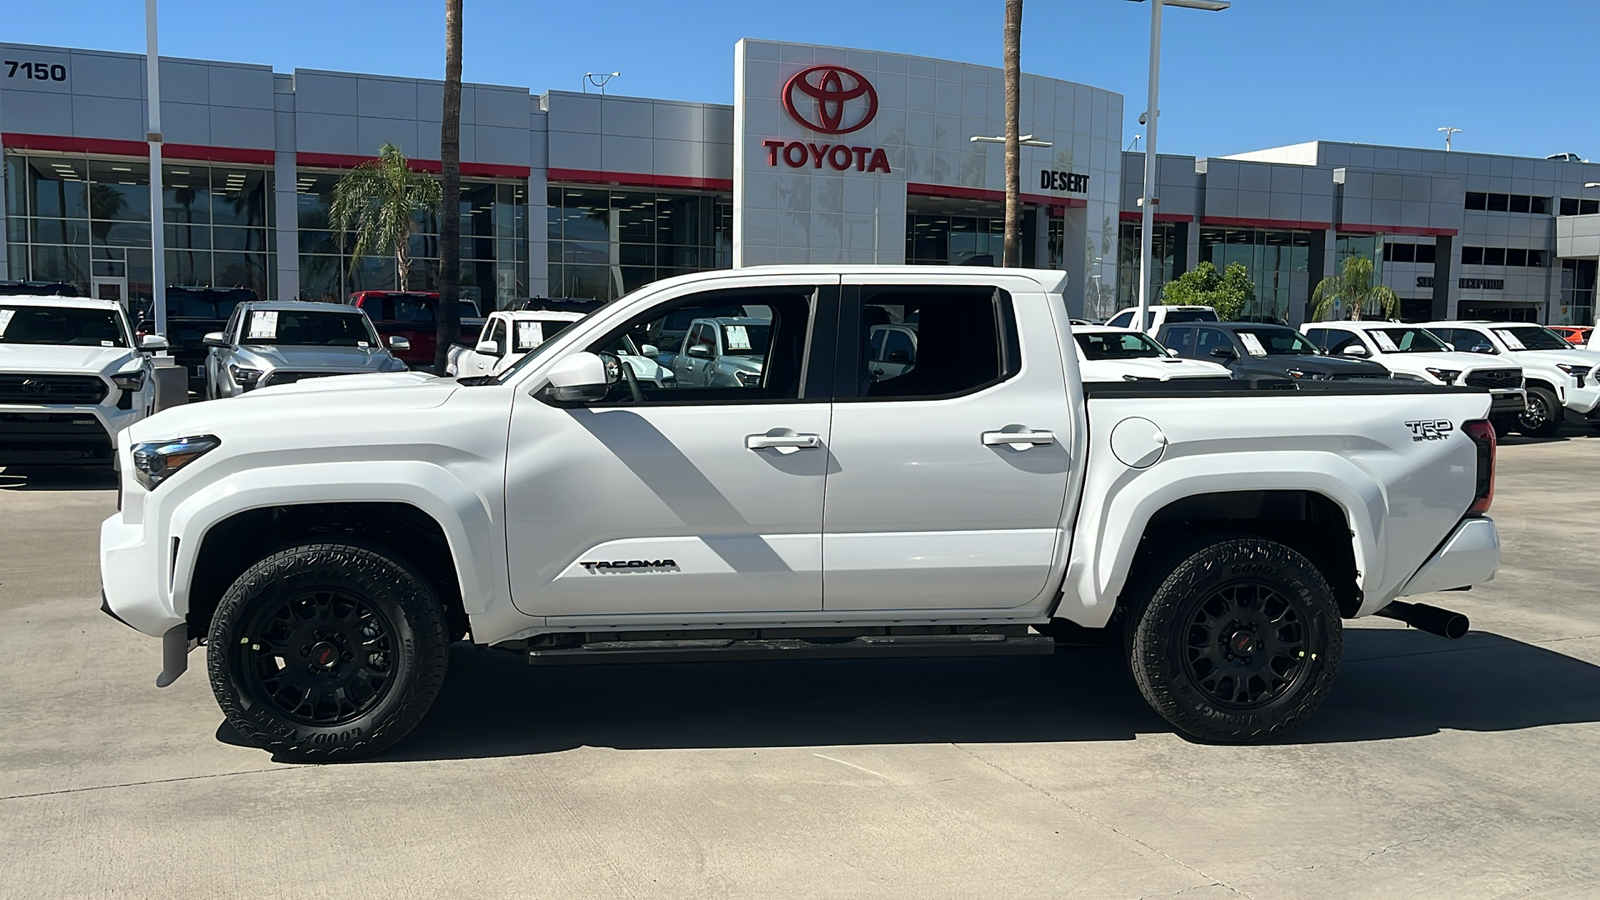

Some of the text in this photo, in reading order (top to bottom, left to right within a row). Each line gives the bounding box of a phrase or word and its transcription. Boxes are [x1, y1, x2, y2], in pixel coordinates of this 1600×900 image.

[4, 60, 67, 82] 7150
[762, 140, 892, 174] TOYOTA
[1040, 169, 1090, 194] DESERT
[1404, 418, 1454, 439] TRD
[579, 558, 677, 570] TACOMA
